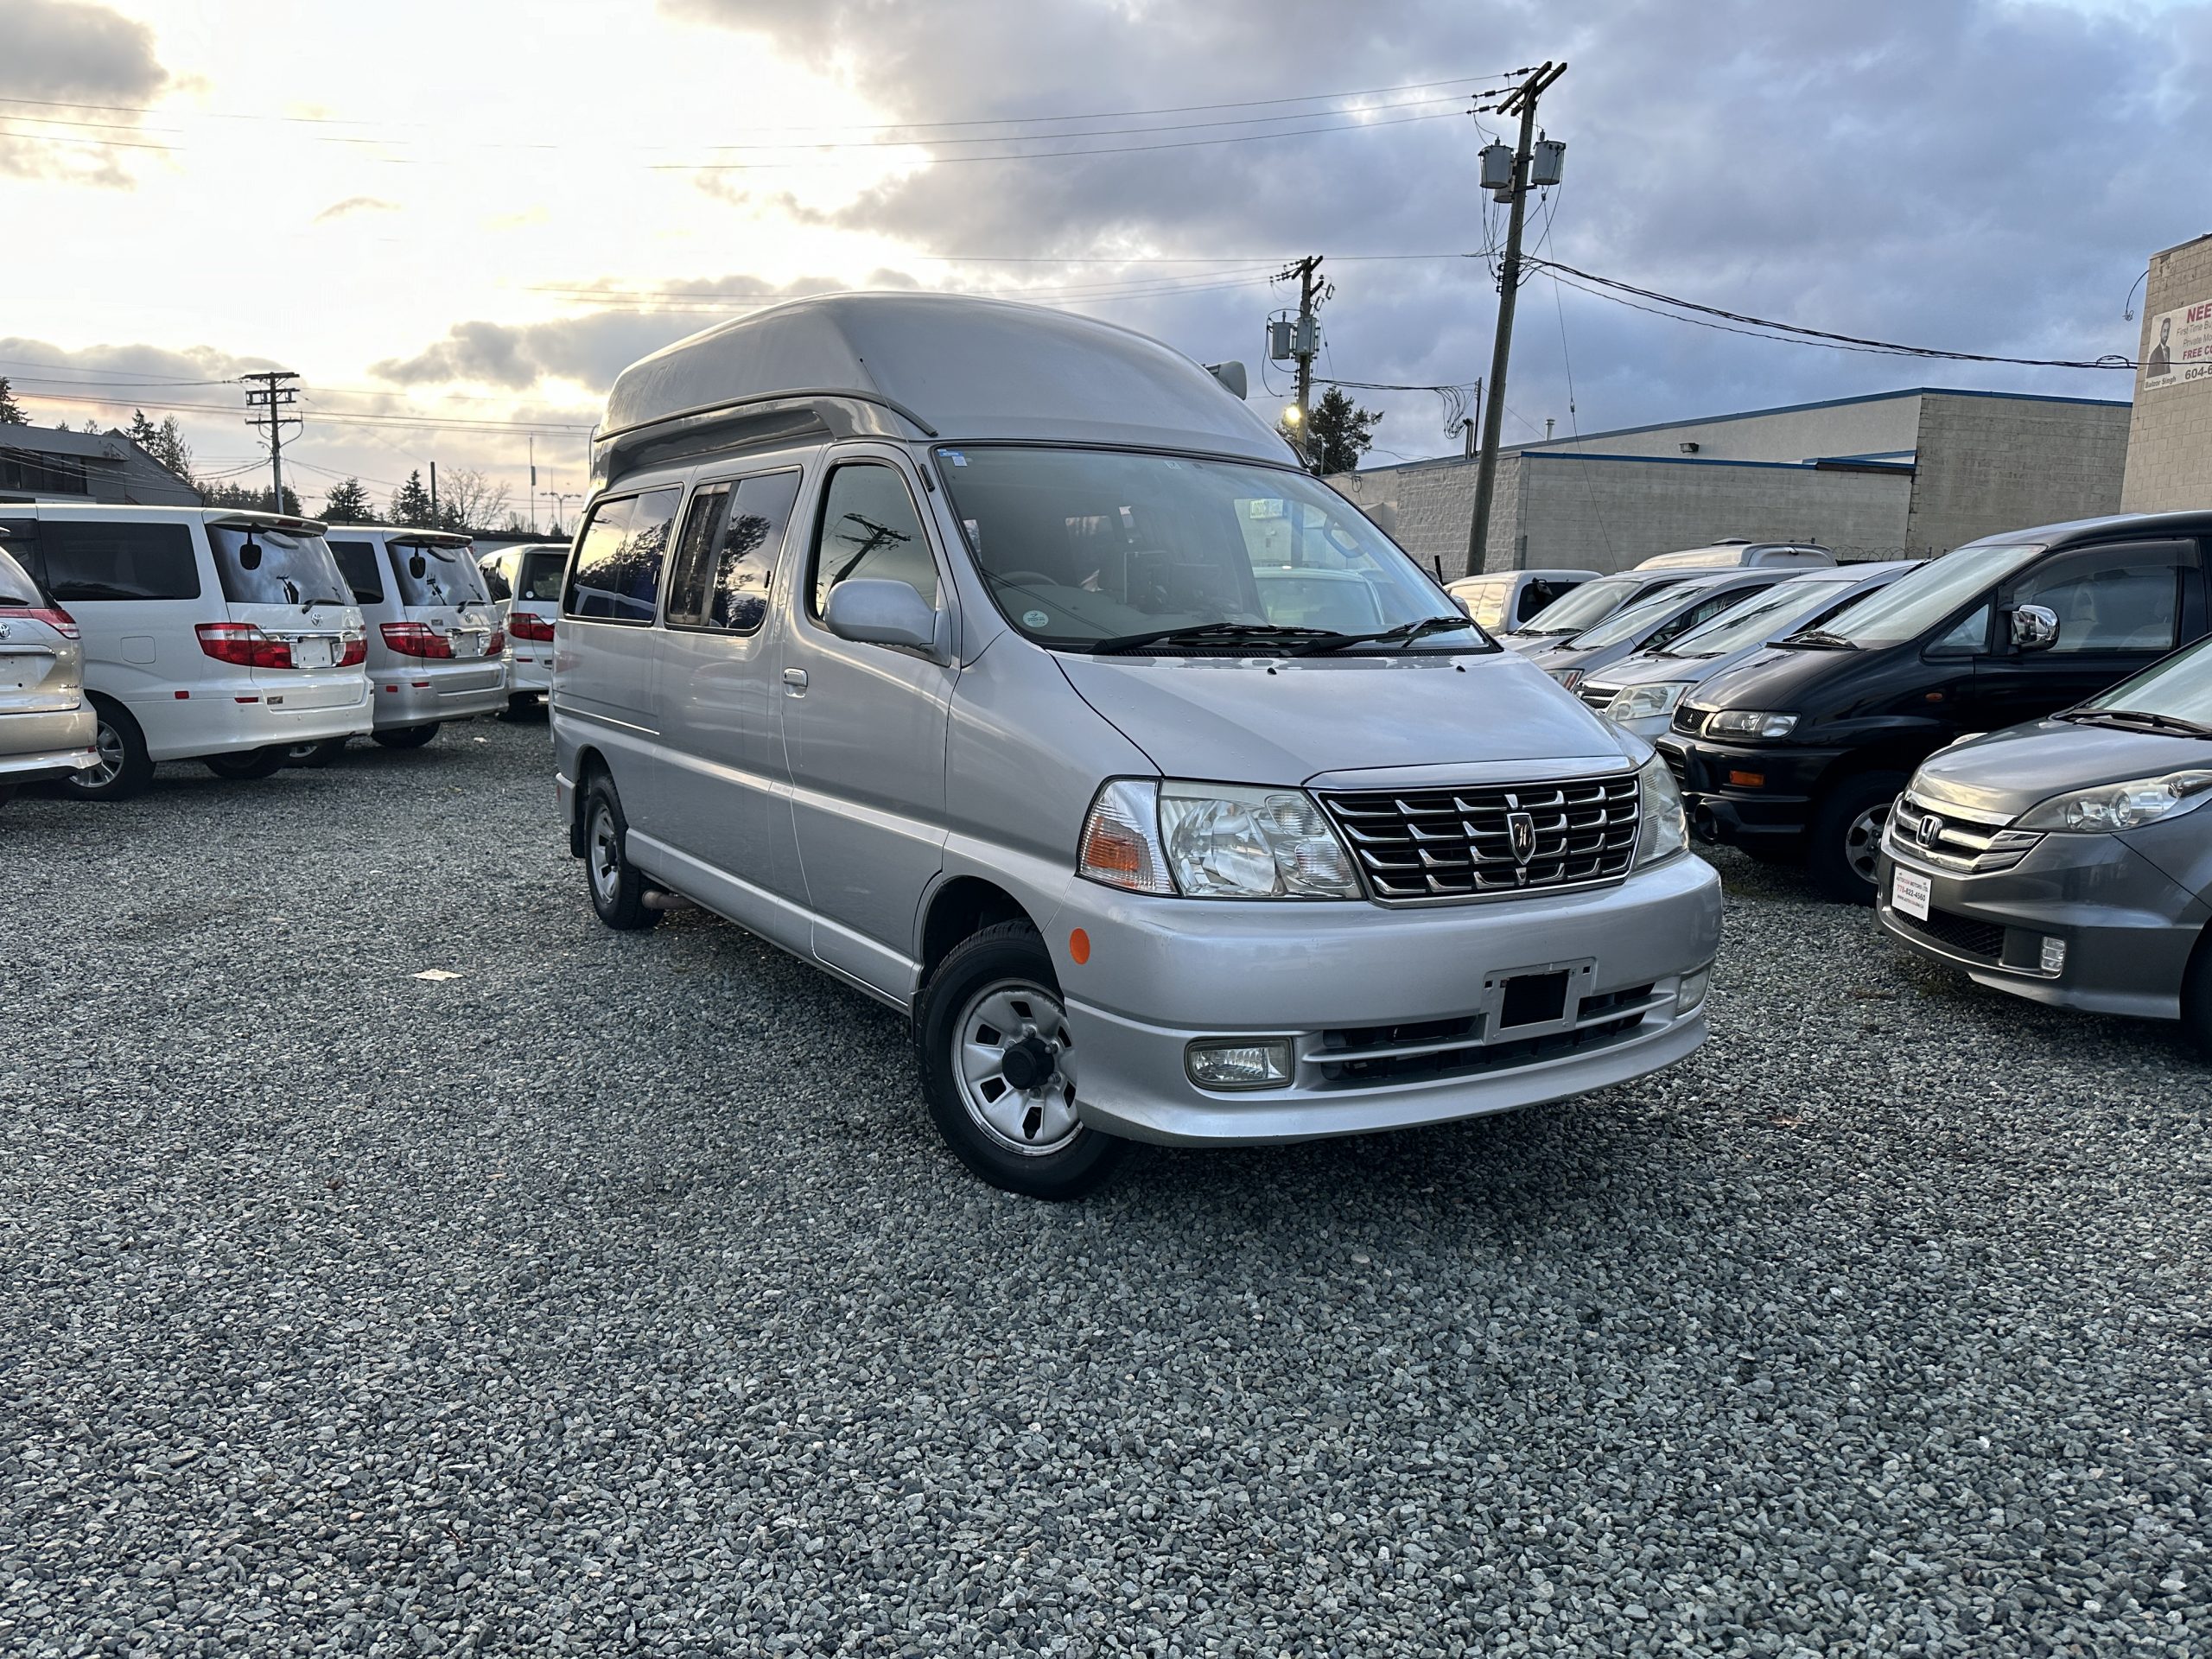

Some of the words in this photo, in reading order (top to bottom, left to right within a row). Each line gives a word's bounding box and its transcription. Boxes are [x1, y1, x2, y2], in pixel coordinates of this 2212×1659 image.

[2183, 347, 2202, 360] FREE
[2185, 365, 2212, 380] 604-6
[2162, 376, 2177, 385] Singh
